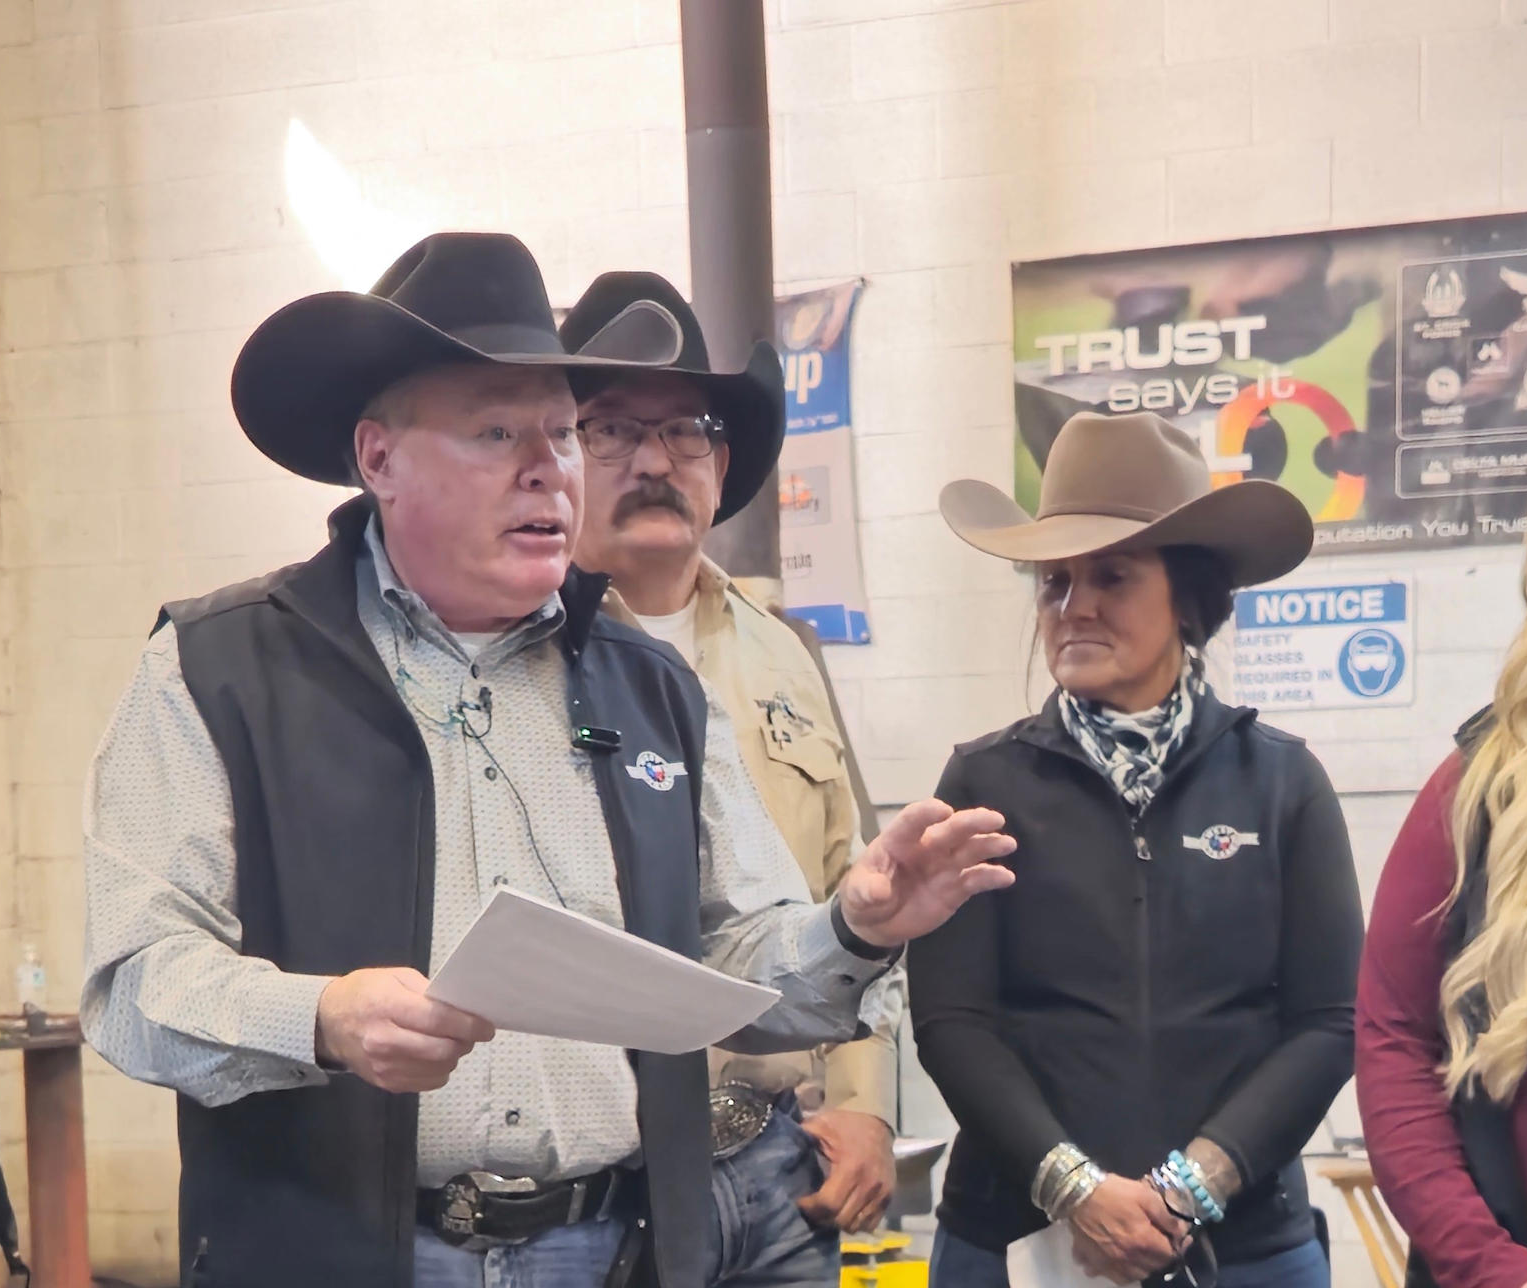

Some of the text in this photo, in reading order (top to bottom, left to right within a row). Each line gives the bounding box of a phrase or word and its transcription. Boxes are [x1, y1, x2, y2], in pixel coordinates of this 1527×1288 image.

[1034, 314, 1267, 377] TRUST
[1108, 363, 1296, 416] says it
[1313, 523, 1413, 546] putation
[1422, 520, 1469, 538] You
[1255, 588, 1385, 625] NOTICE
